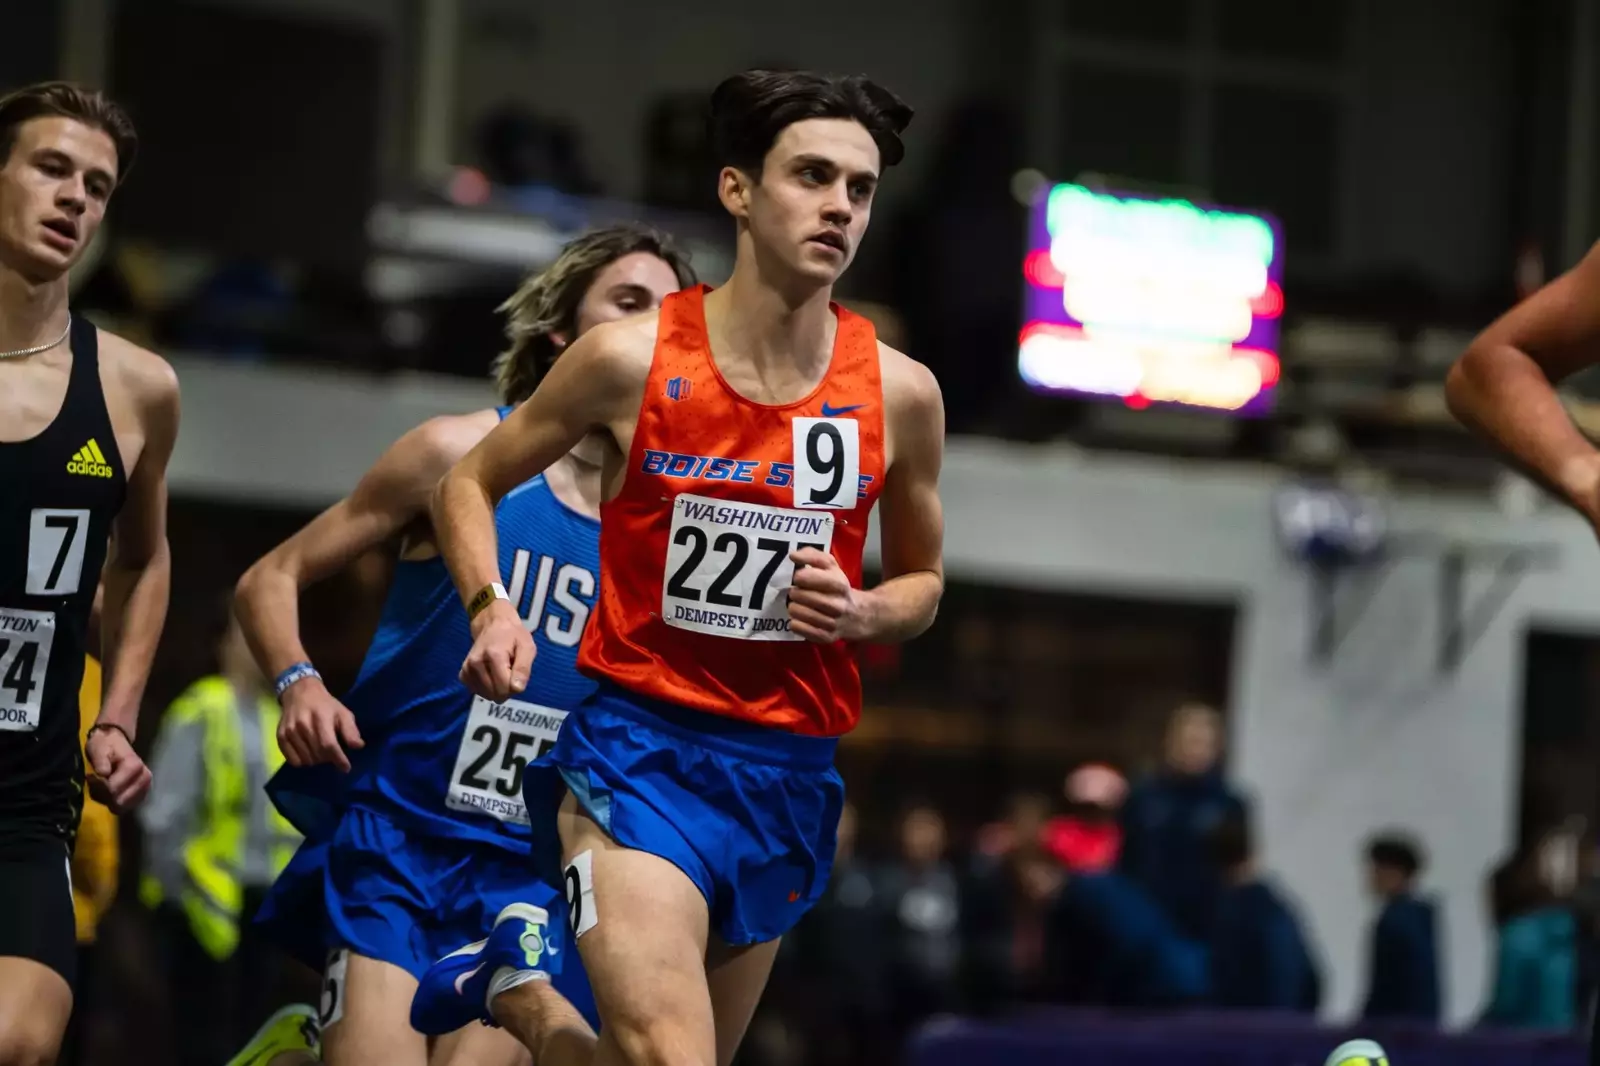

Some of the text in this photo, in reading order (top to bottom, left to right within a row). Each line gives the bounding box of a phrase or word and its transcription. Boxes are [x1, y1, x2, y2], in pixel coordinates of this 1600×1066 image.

[67, 460, 113, 478] adidas
[640, 449, 761, 483] BOISE
[806, 422, 845, 504] 9
[684, 500, 823, 536] WASHINGTON
[44, 515, 79, 590] 7
[667, 525, 825, 610] 227
[674, 605, 792, 632] DEMPSEY INDOO
[487, 703, 564, 731] WASHING
[461, 791, 524, 817] DEMPSEY
